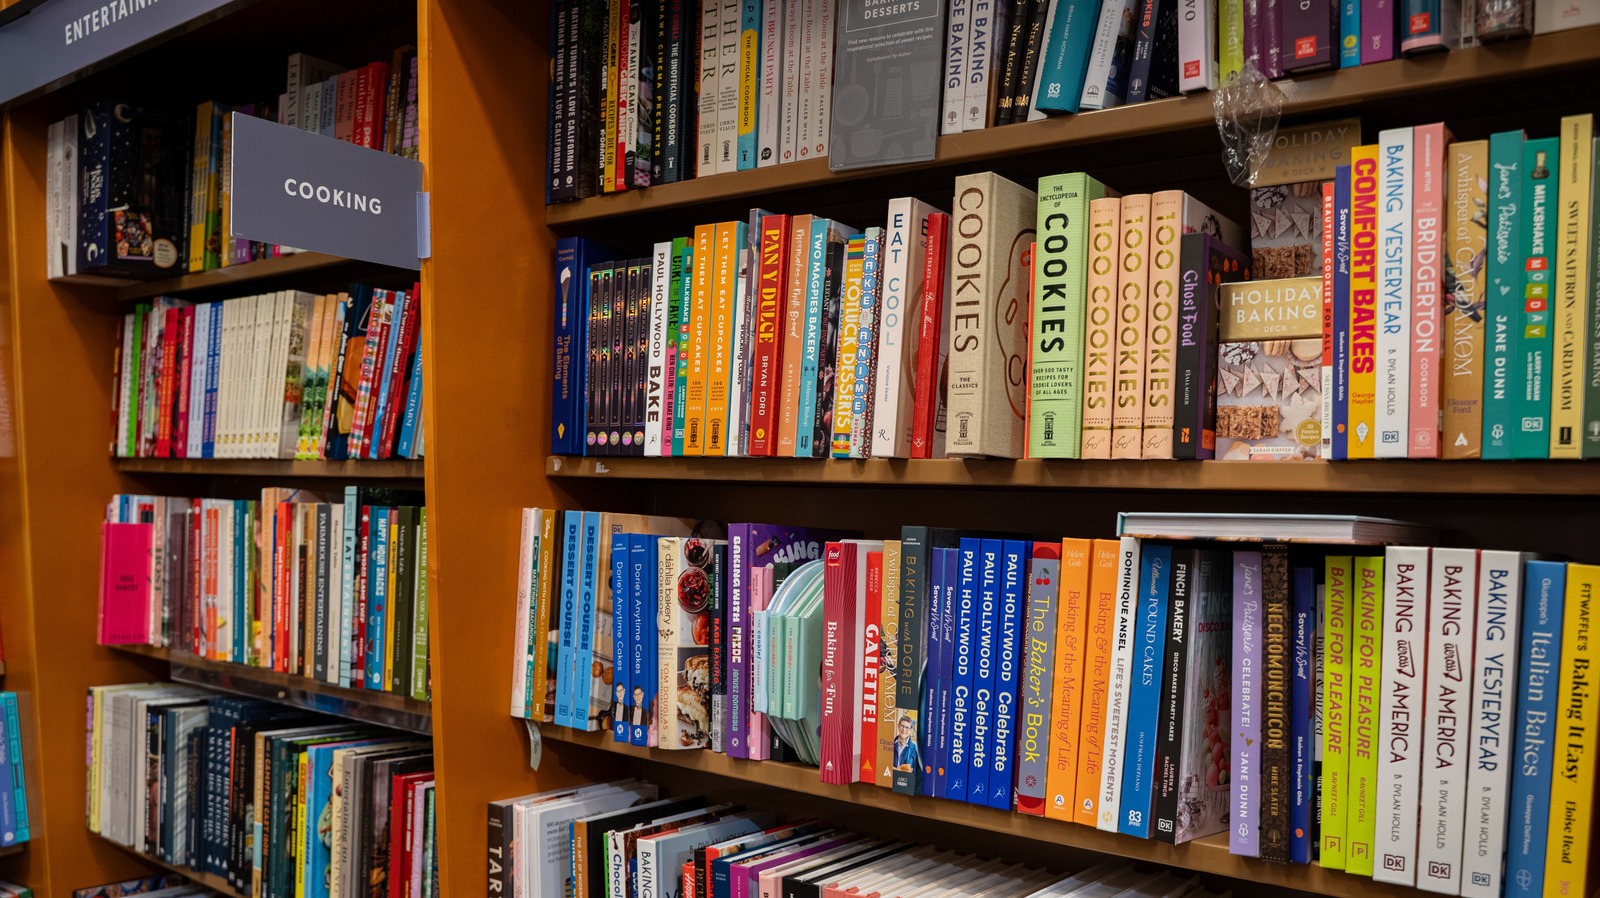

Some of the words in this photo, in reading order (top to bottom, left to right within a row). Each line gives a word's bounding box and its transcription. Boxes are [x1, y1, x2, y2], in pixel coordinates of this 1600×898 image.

[864, 1, 920, 20] DESSERTS
[767, 19, 776, 62] BRUNCH
[892, 30, 914, 38] celebrate
[948, 22, 964, 89] BAKING
[970, 17, 988, 84] BAKING
[670, 58, 678, 102] UNOFFICIAL
[766, 64, 774, 97] PARTY
[1049, 82, 1061, 94] 83
[566, 120, 575, 172] CALIFORNIA
[618, 108, 626, 144] ANIME
[668, 104, 678, 146] COOKBOOK
[284, 178, 382, 215] COOKING
[1040, 192, 1078, 202] ENCYCLOPEDIA
[1384, 144, 1405, 213] BAKING
[890, 213, 904, 264] EAT
[1352, 158, 1377, 282] COMFORT
[764, 229, 780, 266] PAN
[814, 232, 823, 258] TWO
[1092, 218, 1113, 276] 100
[656, 252, 666, 283] PAUL
[763, 270, 778, 282] Y
[810, 261, 821, 314] MAGPIES
[954, 187, 984, 353] COOKIES
[1040, 212, 1070, 354] COOKIES
[1383, 222, 1404, 336] YESTERYEAR
[1415, 217, 1437, 355] BRIDGERTON
[844, 277, 860, 346] POTLUCK
[886, 278, 900, 346] COOL
[1182, 270, 1199, 312] Ghost
[1232, 284, 1323, 306] HOLIDAY
[653, 285, 664, 358] HOLLYWOOD
[758, 288, 777, 344] DULCE
[1182, 312, 1198, 347] Food
[1236, 304, 1317, 324] BAKING
[1264, 324, 1287, 333] DECK
[1352, 289, 1376, 375] BAKES
[1495, 315, 1507, 356] JANE
[694, 315, 703, 374] CUPCAKES
[808, 316, 818, 362] BAKERY
[1087, 284, 1111, 410] COOKIES
[761, 356, 769, 387] BRYAN
[836, 350, 855, 428] DESSERTS
[1420, 358, 1428, 408] COOKBOOK
[1494, 361, 1505, 400] DUNN
[647, 365, 662, 423] BAKE
[758, 390, 766, 416] FORD
[378, 518, 386, 543] HAPPY
[377, 544, 385, 567] HOUR
[567, 524, 576, 587] DESSERT
[586, 526, 596, 590] DESSERT
[732, 536, 741, 588] BAKING
[828, 550, 840, 560] food
[962, 550, 974, 586] PAUL
[984, 552, 995, 588] PAUL
[376, 568, 384, 598] SNACKS
[616, 561, 624, 594] Dorie's
[904, 556, 917, 619] BAKING
[1120, 550, 1132, 616] DOMINIQUE
[1175, 563, 1187, 597] FINCH
[1330, 566, 1345, 632] BAKING
[1394, 564, 1416, 634] BAKING
[563, 590, 574, 648] COURSE
[580, 594, 590, 651] COURSE
[616, 596, 624, 639] Anytime
[732, 590, 740, 622] WITH
[1033, 595, 1050, 632] The
[1064, 590, 1081, 633] Baking
[1172, 600, 1185, 644] BAKERY
[1486, 569, 1509, 642] BAKING
[1577, 582, 1591, 652] FITWAFFLE'S
[731, 626, 742, 664] PRIDE
[958, 588, 972, 676] HOLLYWOOD
[979, 591, 993, 679] HOLLYWOOD
[1063, 634, 1078, 651] &
[1118, 616, 1128, 651] ANSEL
[1328, 633, 1344, 666] FOR
[616, 641, 624, 671] Cakes
[862, 624, 880, 724] GALETTE!
[902, 644, 914, 696] DORIE
[1028, 636, 1048, 708] Baker's
[1064, 654, 1078, 674] the
[1116, 658, 1125, 692] LIFE'S
[1266, 603, 1284, 750] NECROMUNCHICON
[1528, 630, 1553, 702] Italian
[1060, 676, 1076, 733] Meaning
[1566, 658, 1590, 720] Baking
[952, 686, 968, 764] Celebrate
[973, 688, 990, 768] Celebrate
[1110, 692, 1123, 748] SWEETEST
[1327, 671, 1343, 755] PLEASURE
[1390, 680, 1410, 764] AMERICA
[1478, 653, 1505, 772] YESTERYEAR
[1568, 725, 1586, 743] It
[1024, 712, 1043, 764] Book
[1056, 748, 1071, 772] Life
[1057, 732, 1071, 748] of
[1522, 710, 1548, 778] Bakes
[1105, 750, 1118, 804] MOMENTS
[1270, 766, 1278, 784] MIKE
[1560, 743, 1584, 785] Easy
[1330, 771, 1338, 802] RAVNEET
[1392, 782, 1402, 808] DYLAN
[1480, 794, 1490, 823] DYLAN
[1128, 810, 1142, 822] 83
[1390, 810, 1400, 843] HOLLIS
[1478, 825, 1488, 858] HOLLIS
